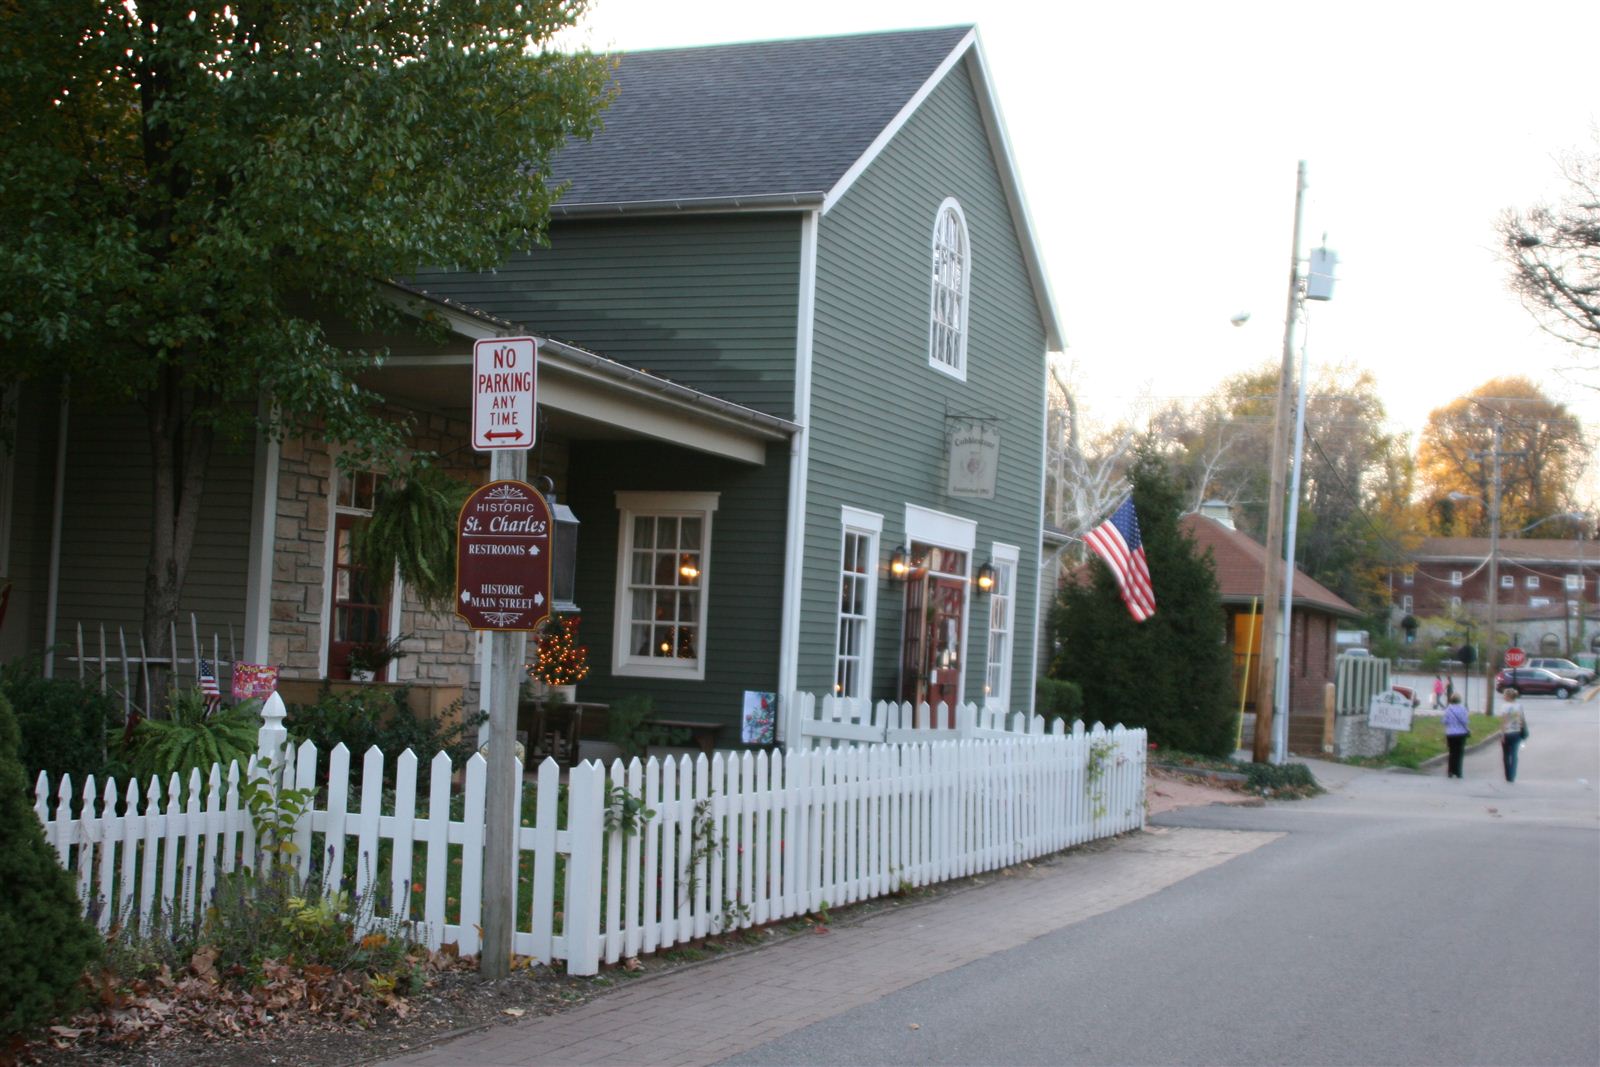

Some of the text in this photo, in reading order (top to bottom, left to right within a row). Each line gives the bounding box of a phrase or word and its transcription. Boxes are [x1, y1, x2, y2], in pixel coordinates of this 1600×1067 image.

[494, 348, 516, 369] NO
[479, 372, 531, 394] PARKING
[493, 395, 516, 410] ANY
[490, 411, 518, 426] TIME
[477, 503, 535, 513] HISTORIC
[464, 515, 546, 533] St. Charles
[469, 544, 525, 556] RESTROOMS
[481, 584, 524, 596] HISTORIC
[471, 597, 533, 609] MAIN STREET
[1506, 653, 1524, 662] STOP
